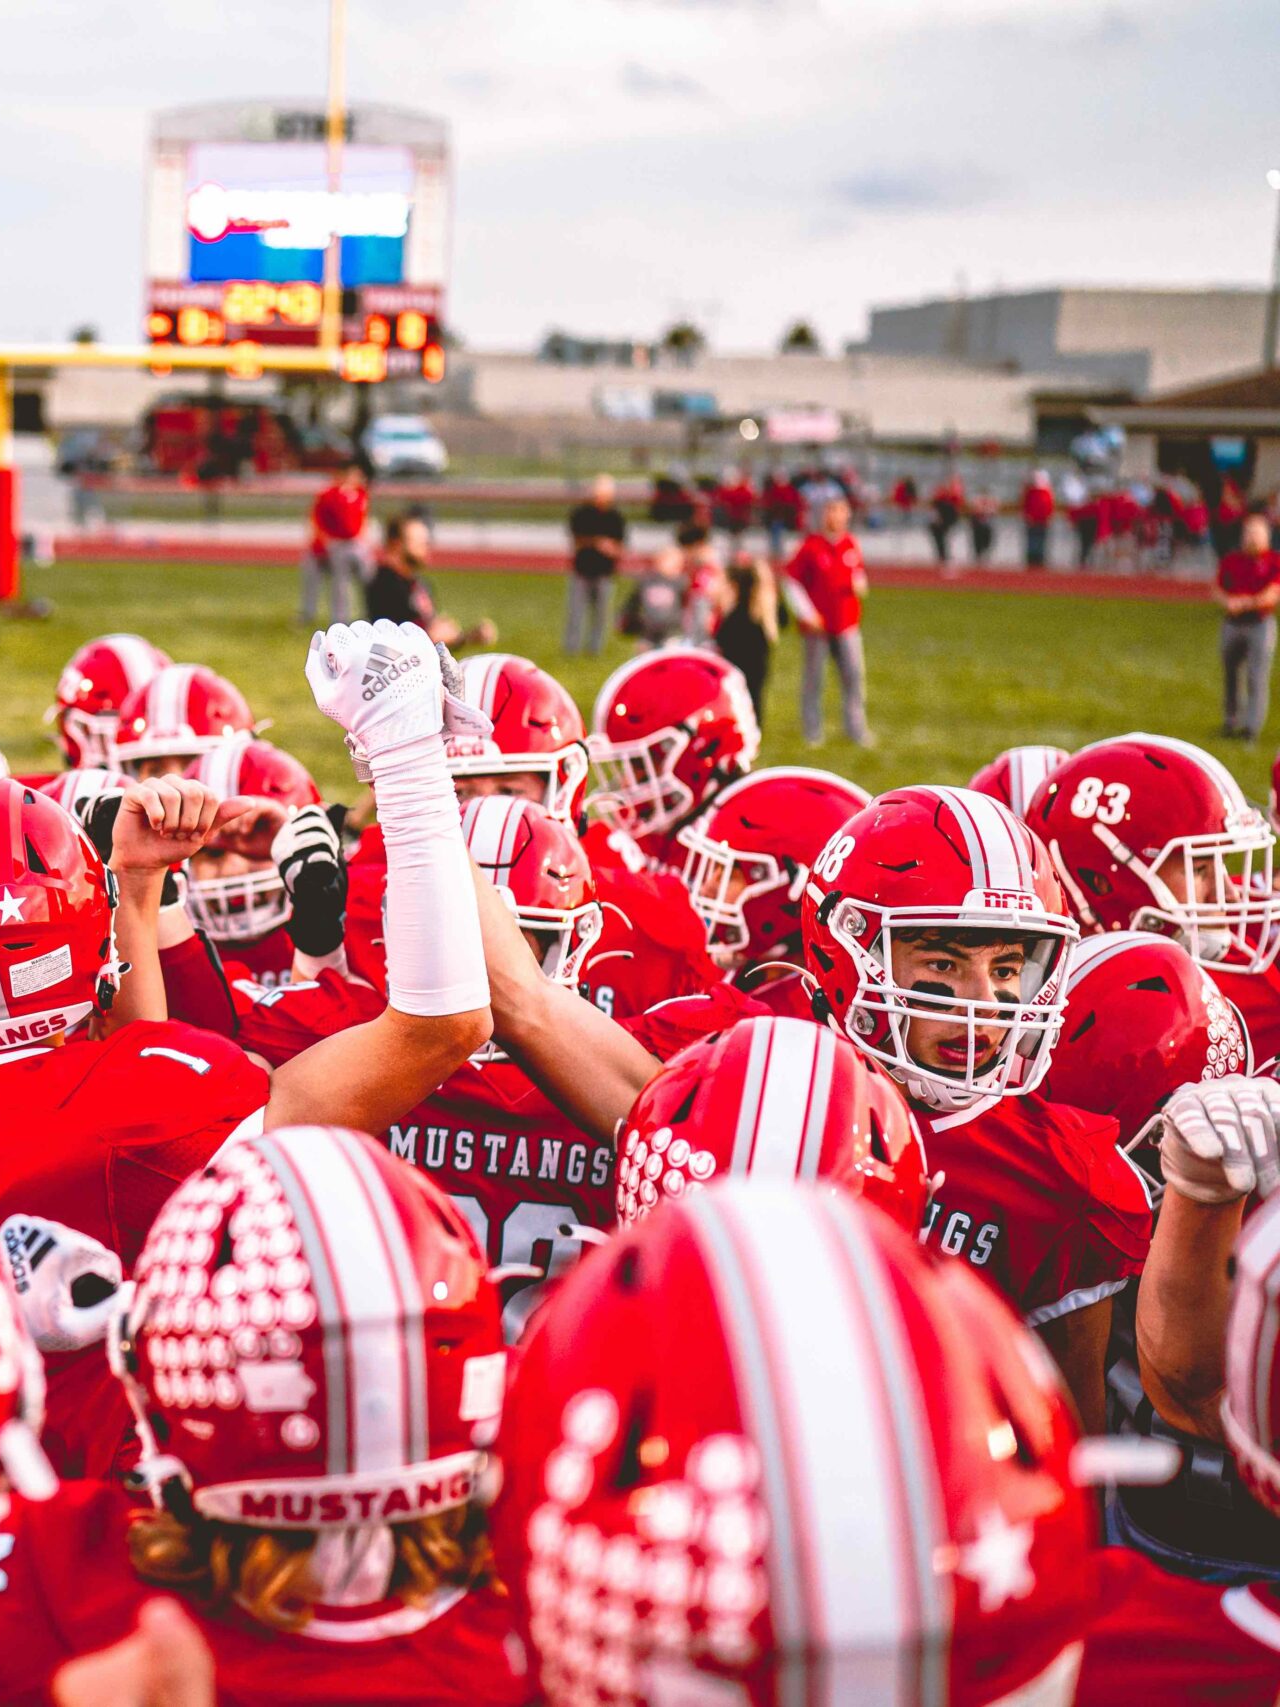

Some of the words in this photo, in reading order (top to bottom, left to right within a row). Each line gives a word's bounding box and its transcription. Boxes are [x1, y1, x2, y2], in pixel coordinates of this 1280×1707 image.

[361, 655, 421, 701] adidas
[1070, 776, 1131, 825] 83
[813, 829, 856, 883] 88
[982, 891, 1033, 911] DCG
[388, 1124, 612, 1186] MUSTANGS
[5, 1228, 30, 1295] adidas
